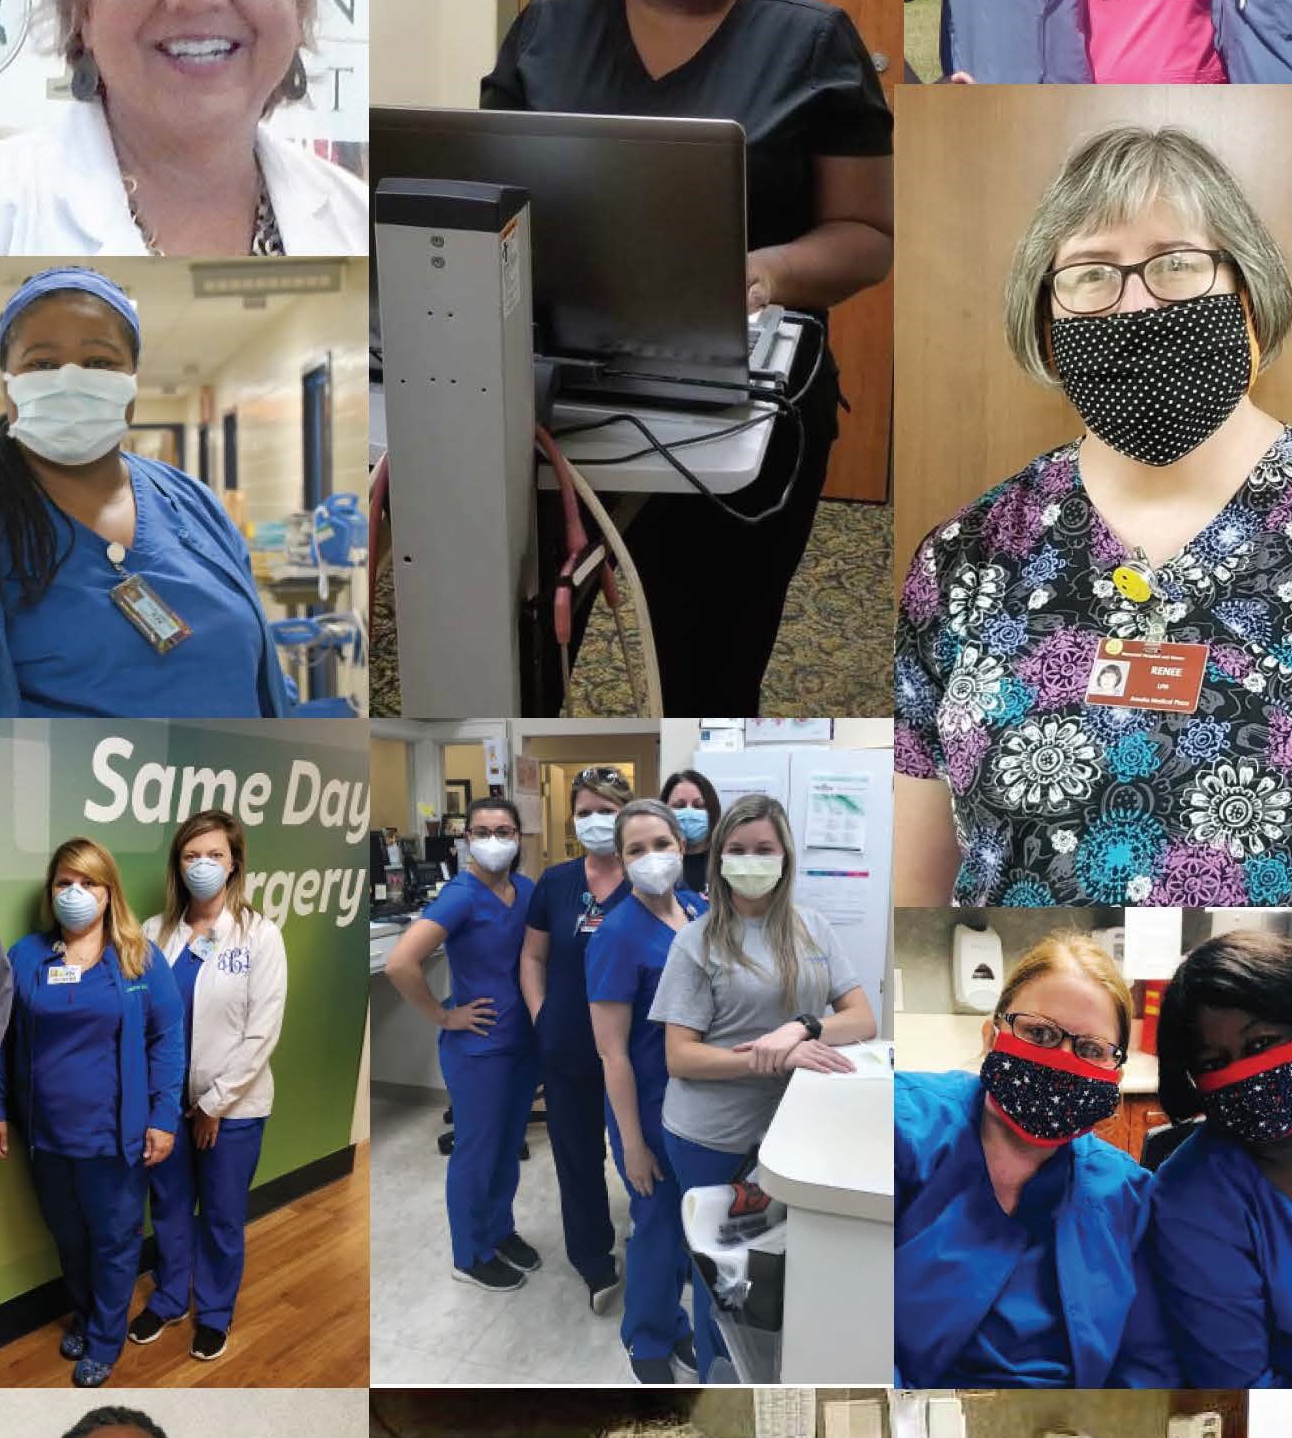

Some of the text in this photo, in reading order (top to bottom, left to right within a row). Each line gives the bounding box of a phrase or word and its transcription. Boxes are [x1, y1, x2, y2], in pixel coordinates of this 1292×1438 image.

[1150, 665, 1184, 677] RENEE
[83, 736, 370, 845] Same Day
[244, 867, 367, 932] rgery
